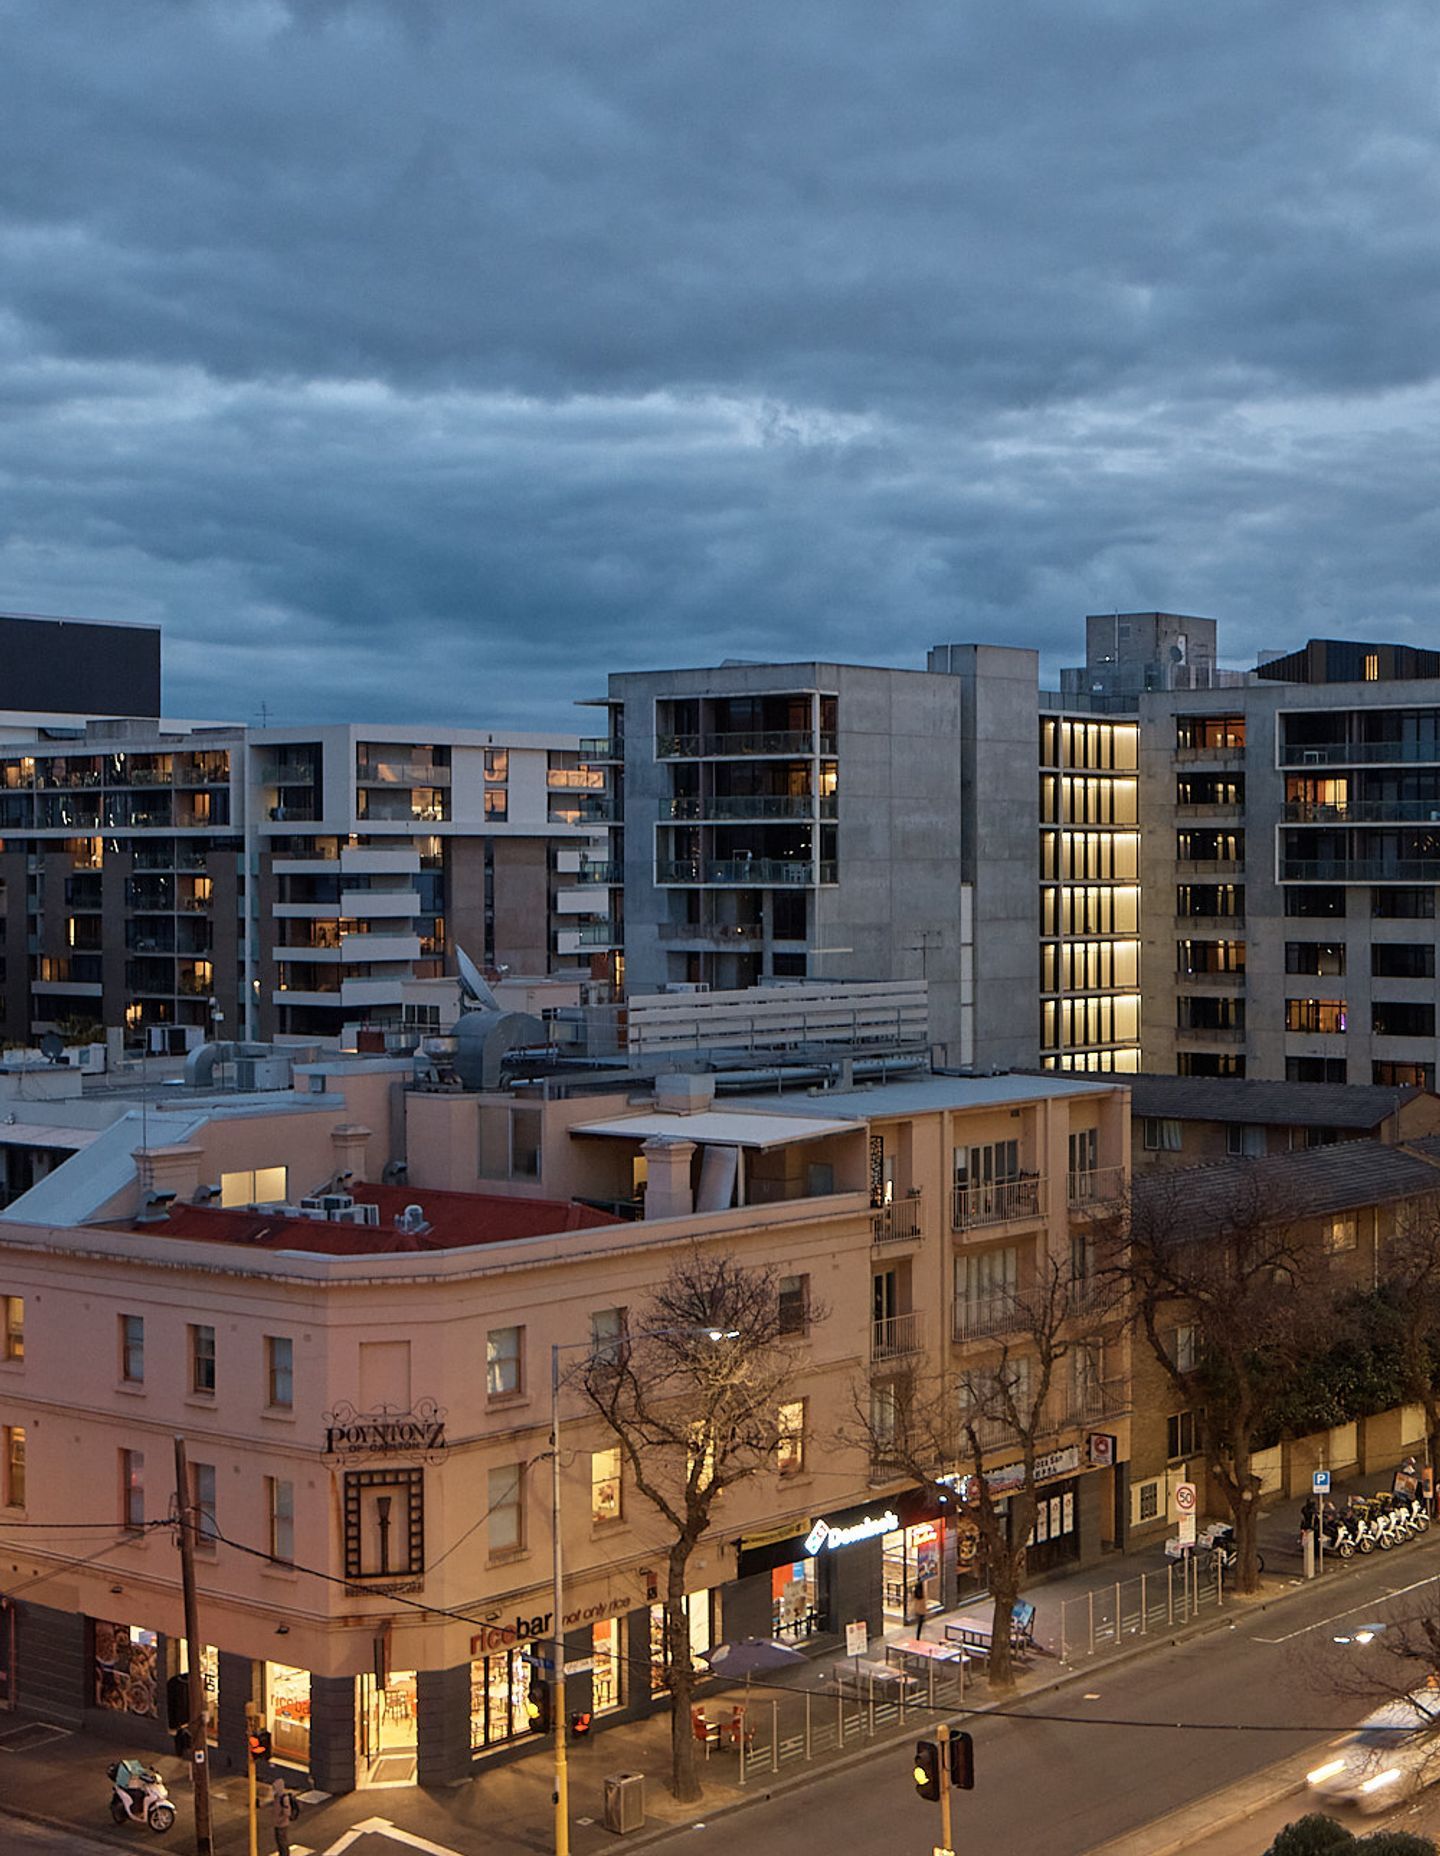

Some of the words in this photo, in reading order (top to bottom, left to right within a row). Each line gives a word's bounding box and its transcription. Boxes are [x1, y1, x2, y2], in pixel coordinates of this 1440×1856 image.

[1317, 1474, 1326, 1485] P
[1180, 1491, 1192, 1504] 50
[562, 1609, 582, 1626] not
[583, 1602, 607, 1619] only
[609, 1596, 631, 1613] rice
[270, 1693, 311, 1714] riceba
